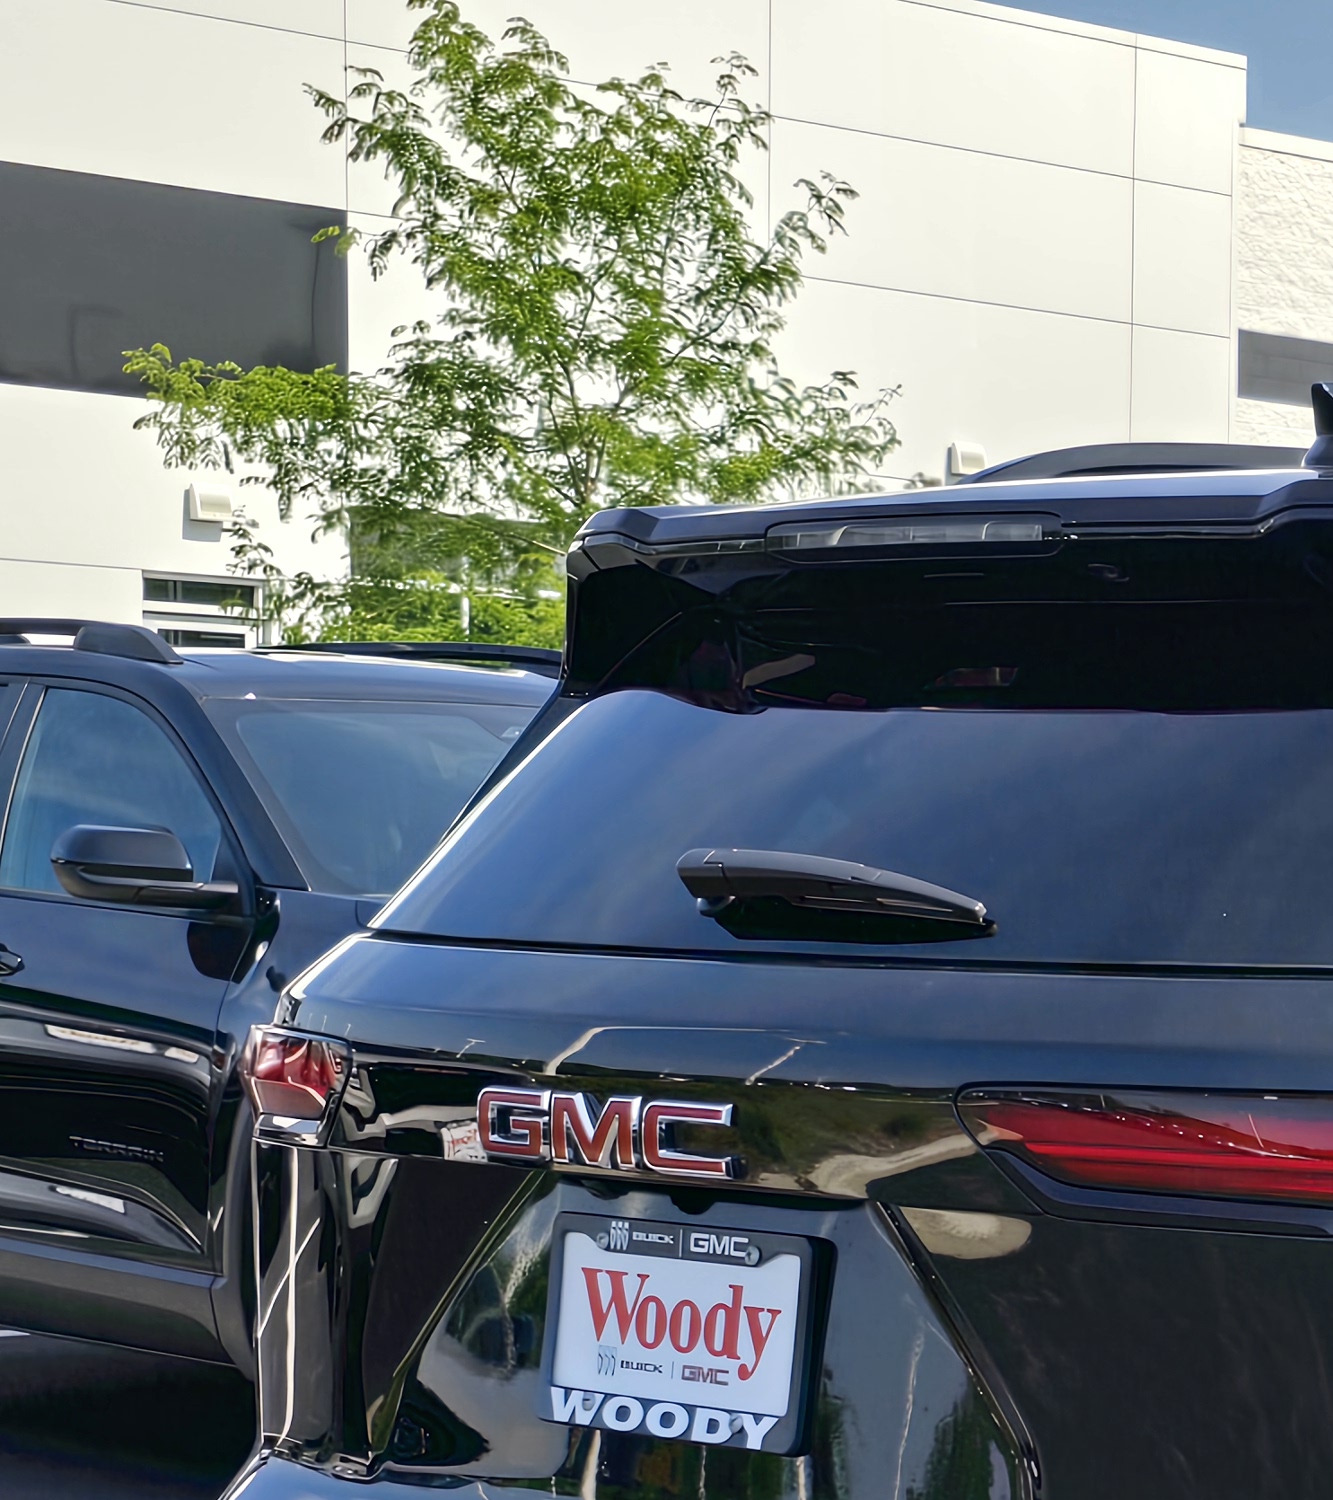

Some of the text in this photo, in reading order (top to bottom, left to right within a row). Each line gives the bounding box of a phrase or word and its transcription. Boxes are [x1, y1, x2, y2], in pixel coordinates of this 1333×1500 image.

[477, 1085, 743, 1180] GMC
[632, 1231, 750, 1258] BUICK GMC
[581, 1267, 782, 1381] Woody
[620, 1360, 730, 1386] BUICK GMC
[550, 1386, 779, 1450] WOODY
